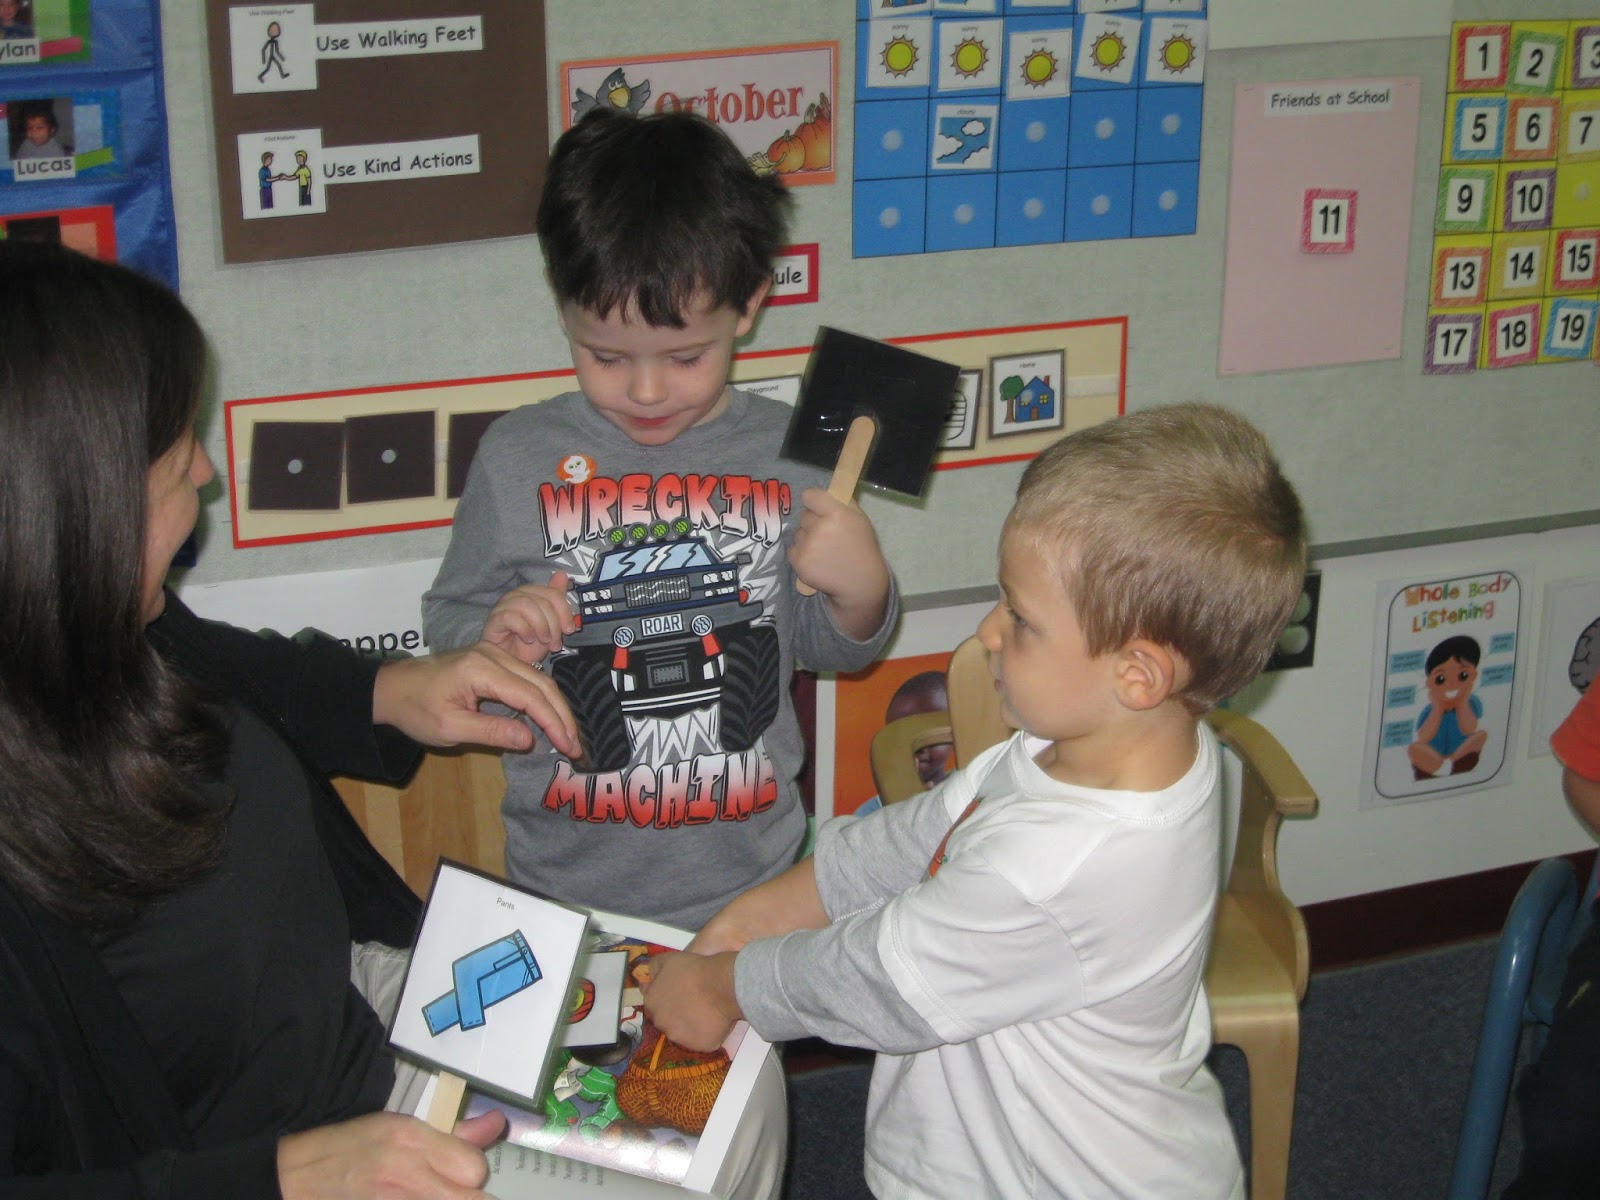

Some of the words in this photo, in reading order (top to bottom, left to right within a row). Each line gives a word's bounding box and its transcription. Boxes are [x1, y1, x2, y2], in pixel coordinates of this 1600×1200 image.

[316, 36, 350, 51] Use
[358, 30, 427, 49] Walking
[435, 25, 476, 43] Feet
[1478, 42, 1489, 72] 1
[1526, 48, 1544, 78] 2
[1270, 92, 1321, 108] Friends
[1326, 93, 1342, 106] at
[1346, 89, 1391, 105] School
[1471, 113, 1488, 143] 5
[1526, 113, 1541, 143] 6
[1579, 116, 1594, 146] 7
[17, 159, 72, 175] Lucas
[323, 163, 357, 178] Use
[364, 156, 401, 175] Kind
[409, 153, 474, 171] Actions
[1457, 184, 1473, 214] 9
[1516, 184, 1543, 214] 10
[1318, 204, 1341, 235] 11
[1509, 251, 1535, 281] 14
[1567, 244, 1592, 273] 15
[771, 266, 802, 285] ule
[1449, 261, 1476, 291] 13
[1440, 328, 1468, 357] 17
[1500, 320, 1528, 350] 18
[1560, 313, 1585, 342] 19
[538, 472, 792, 558] WRECKIN'
[1467, 574, 1513, 599] Body
[643, 616, 681, 636] ROAR
[1411, 600, 1495, 633] Listening
[541, 751, 778, 830] MACHINE
[496, 897, 515, 910] Pants
